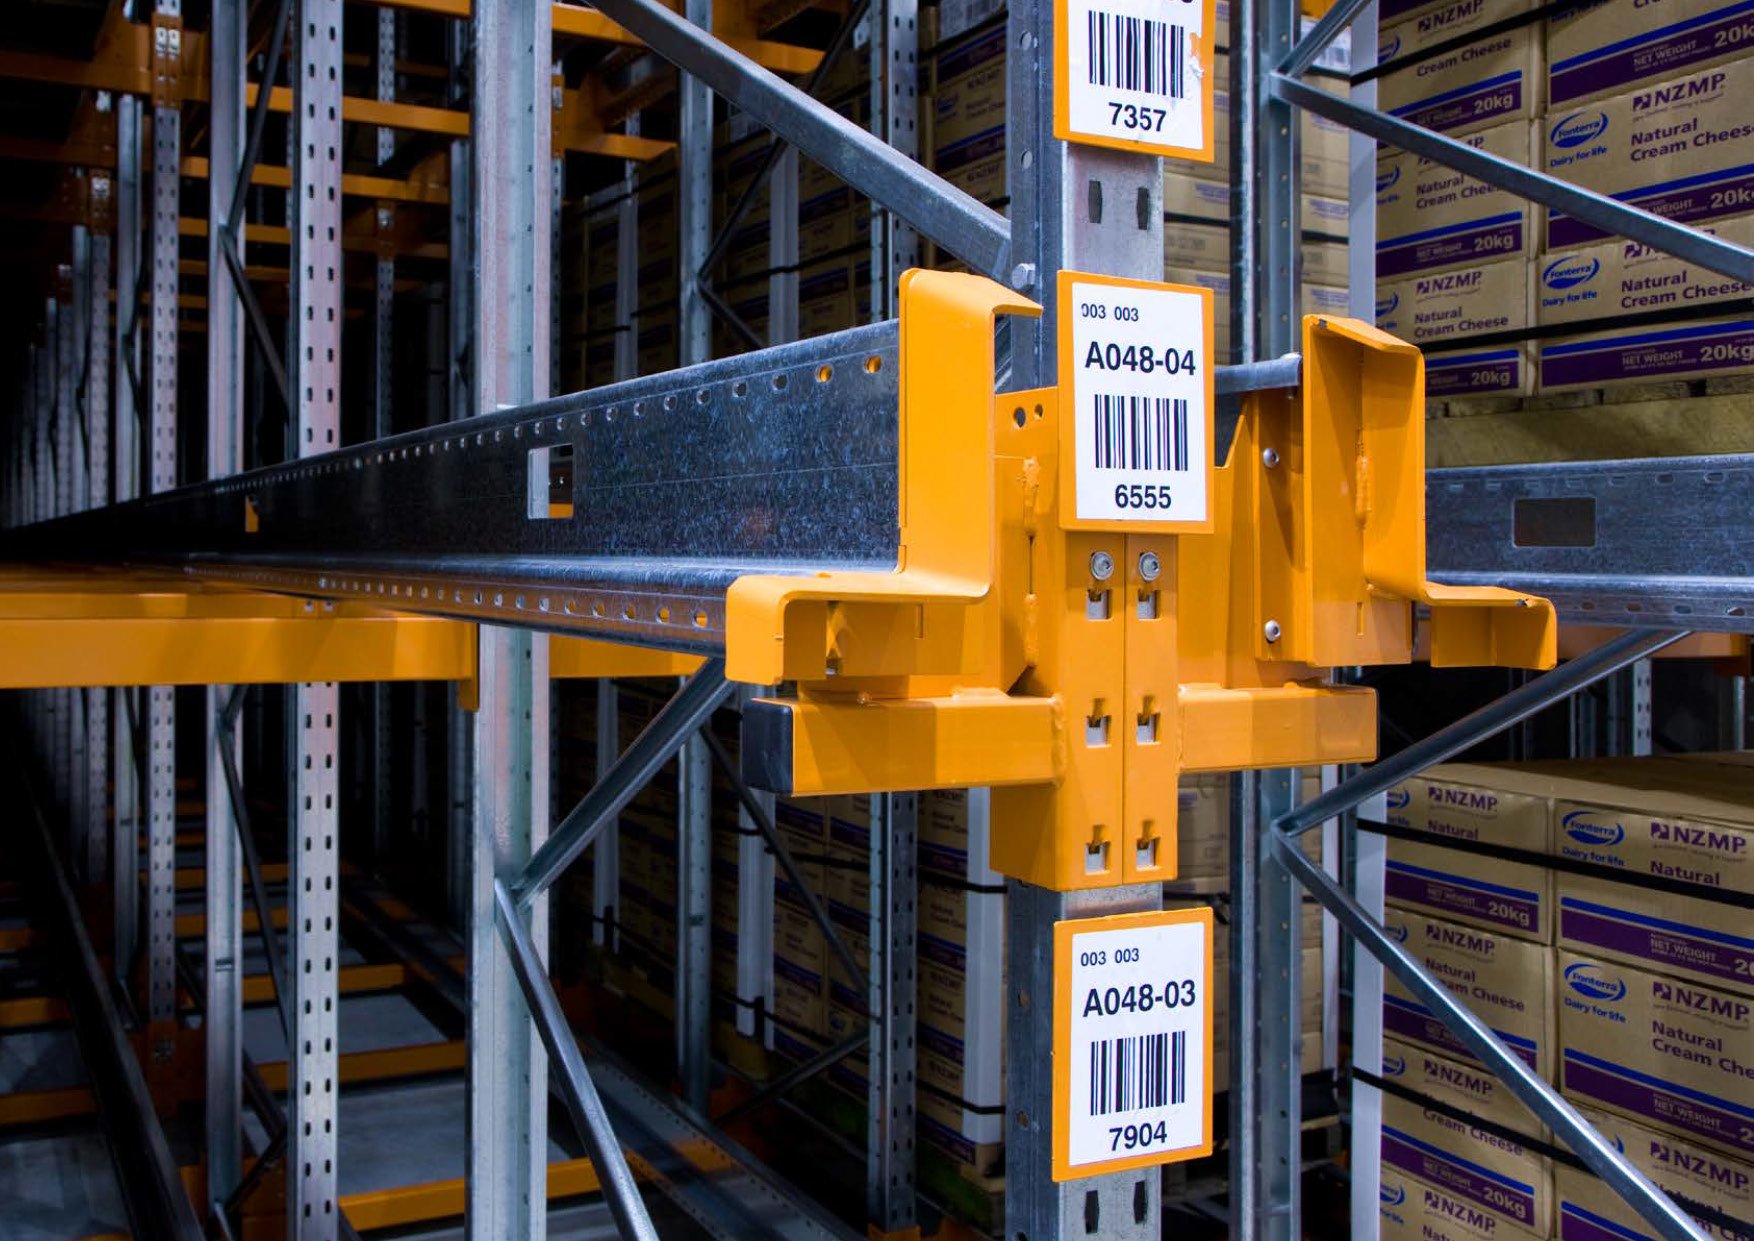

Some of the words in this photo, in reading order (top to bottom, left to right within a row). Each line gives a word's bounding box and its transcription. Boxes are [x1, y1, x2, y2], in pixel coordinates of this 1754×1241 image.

[1433, 0, 1483, 25] NZMP
[1715, 24, 1754, 47] 20k
[1417, 57, 1457, 77] Cream
[1461, 38, 1512, 62] Cheese
[1654, 73, 1726, 107] NZMP
[1108, 101, 1167, 132] 7357
[1474, 94, 1513, 114] 20kg
[1630, 141, 1687, 162] Cream
[1693, 124, 1754, 147] Chees
[1631, 118, 1698, 146] Natural
[1550, 152, 1574, 168] Dairy
[1576, 149, 1590, 160] for
[1591, 146, 1607, 157] life
[1416, 174, 1464, 195] Natural
[1416, 192, 1457, 209] Cream
[1461, 184, 1502, 199] Chee
[1711, 188, 1754, 209] 20k
[1474, 233, 1514, 251] 20kg
[1432, 271, 1482, 292] NZMP
[1622, 270, 1687, 293] Natural
[1542, 295, 1564, 307] Dairy
[1567, 292, 1580, 302] for
[1622, 291, 1676, 308] Cream
[1683, 282, 1751, 300] Cheese
[1081, 303, 1106, 319] 003
[1114, 306, 1139, 322] 003
[1415, 307, 1462, 324] Natural
[1414, 323, 1454, 338] Cream
[1458, 316, 1509, 331] Cheese
[1085, 341, 1196, 375] A048-04
[1700, 345, 1754, 363] 20kg
[1471, 371, 1510, 386] 20kg
[1115, 484, 1172, 509] 6555
[1446, 789, 1497, 811] NZMP
[1428, 820, 1478, 840] Natural
[1674, 826, 1746, 853] NZMP
[1562, 846, 1588, 862] Dairy
[1590, 851, 1605, 863] for
[1651, 861, 1720, 886] Natural
[1489, 901, 1529, 927] 20kg
[1443, 928, 1495, 954] NZMP
[1081, 951, 1106, 966] 003
[1115, 948, 1140, 964] 003
[1426, 958, 1476, 982] Natural
[1083, 979, 1196, 1018] A048-03
[1472, 987, 1525, 1011] Cheese
[1564, 997, 1590, 1014] Dairy
[1592, 1004, 1607, 1017] for
[1608, 1009, 1626, 1023] life
[1676, 988, 1749, 1021] NZMP
[1652, 1020, 1722, 1053] Natural
[1652, 1038, 1712, 1066] Cream
[1719, 1058, 1754, 1079] Che
[1441, 1064, 1493, 1095] NZMP
[1109, 1121, 1167, 1152] 7904
[1423, 1107, 1465, 1134] Cream
[1471, 1125, 1523, 1156] Cheese
[1674, 1150, 1749, 1189] NZMP
[1442, 1198, 1496, 1232] NZMP
[1484, 1186, 1526, 1219] 20kg
